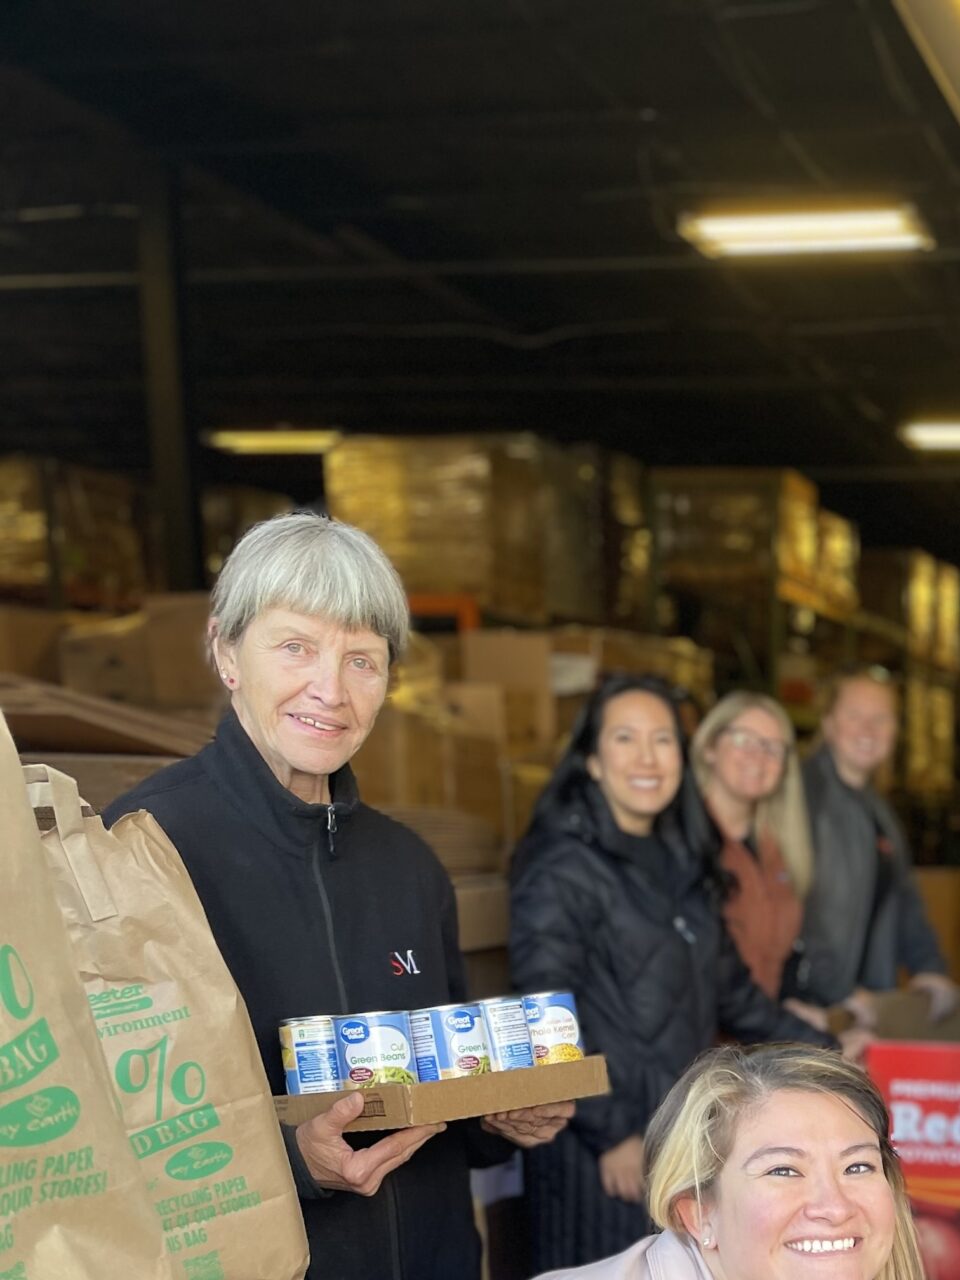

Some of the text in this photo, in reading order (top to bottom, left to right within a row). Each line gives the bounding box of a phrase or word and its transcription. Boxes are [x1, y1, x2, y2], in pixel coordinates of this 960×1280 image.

[447, 1015, 470, 1026] Great
[342, 1026, 364, 1037] Great
[350, 1052, 406, 1065] Green Beans
[457, 1044, 481, 1053] Green
[156, 1110, 209, 1145] BAG
[43, 1146, 94, 1177] PAPER
[39, 1170, 107, 1204] STORES!
[214, 1176, 247, 1199] PAPER
[184, 1227, 208, 1248] BAG
